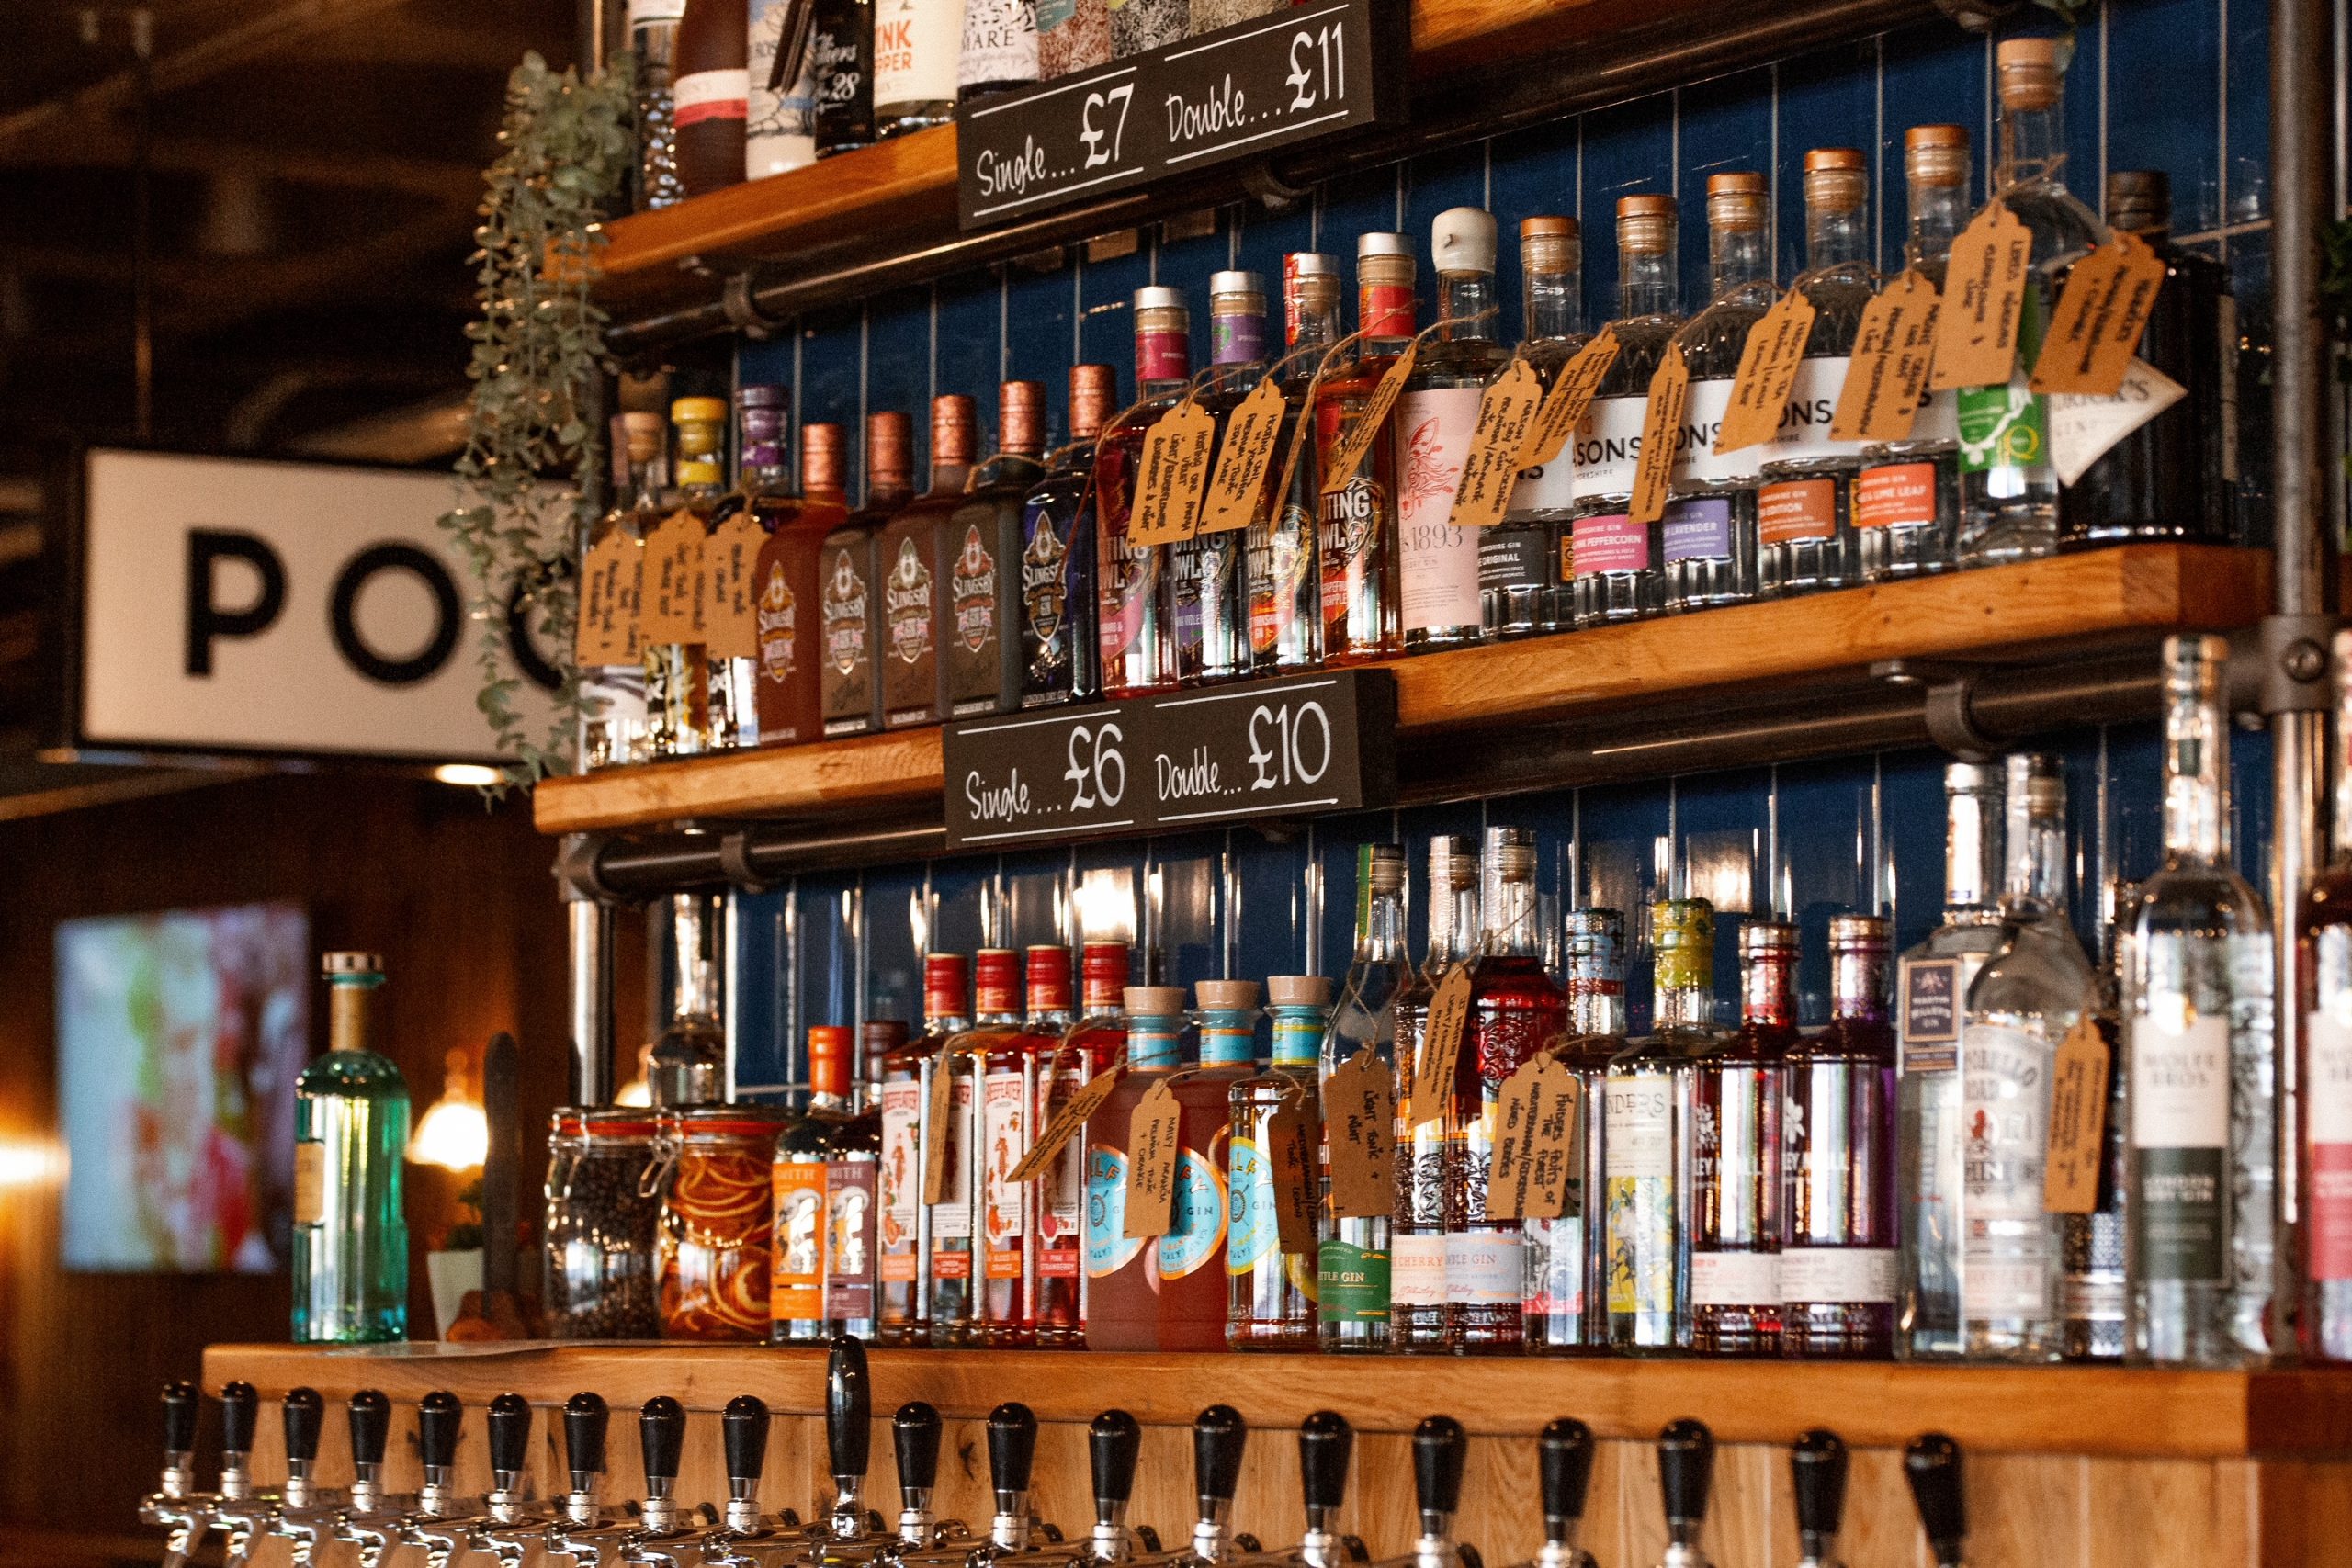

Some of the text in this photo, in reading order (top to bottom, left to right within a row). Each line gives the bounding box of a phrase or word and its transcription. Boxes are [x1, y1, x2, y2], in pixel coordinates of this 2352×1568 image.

[1285, 21, 1344, 114] £11
[1080, 82, 1136, 169] £7
[1191, 430, 1207, 467] HOOTING
[1258, 414, 1276, 455] HOOTING
[1495, 422, 1515, 471] DRY GIN
[1572, 436, 1643, 467] SONS
[1178, 456, 1192, 485] VIOLET
[1188, 473, 1198, 493] OWL
[1225, 463, 1240, 494] TONIC
[1235, 448, 1256, 500] YORKSHIRE
[1140, 505, 1154, 530] MINT
[1671, 522, 1717, 535] LAVENDER
[1587, 535, 1642, 547] PEPPERCORN
[1484, 553, 1521, 565] ORIGINAL
[1248, 701, 1331, 792] £10
[1064, 723, 1125, 812] £6
[1363, 1090, 1379, 1120] LIGHT
[1507, 1097, 1524, 1129] MIXED
[1552, 1093, 1572, 1141] FINDERS
[1348, 1114, 1362, 1144] MINT
[1541, 1114, 1553, 1135] THE
[1146, 1118, 1159, 1192] PREMIUM TONIC
[1159, 1116, 1175, 1202] MALFY ARANCIA
[1366, 1129, 1383, 1158] TONIC
[1136, 1148, 1145, 1187] ORANGE
[1545, 1149, 1563, 1184] FRUITS
[1186, 1206, 1214, 1216] GIN
[1292, 1186, 1302, 1217] LEMON
[1397, 1255, 1443, 1268] CHERRY
[1472, 1254, 1498, 1266] GIN
[1340, 1271, 1365, 1283] GIN
